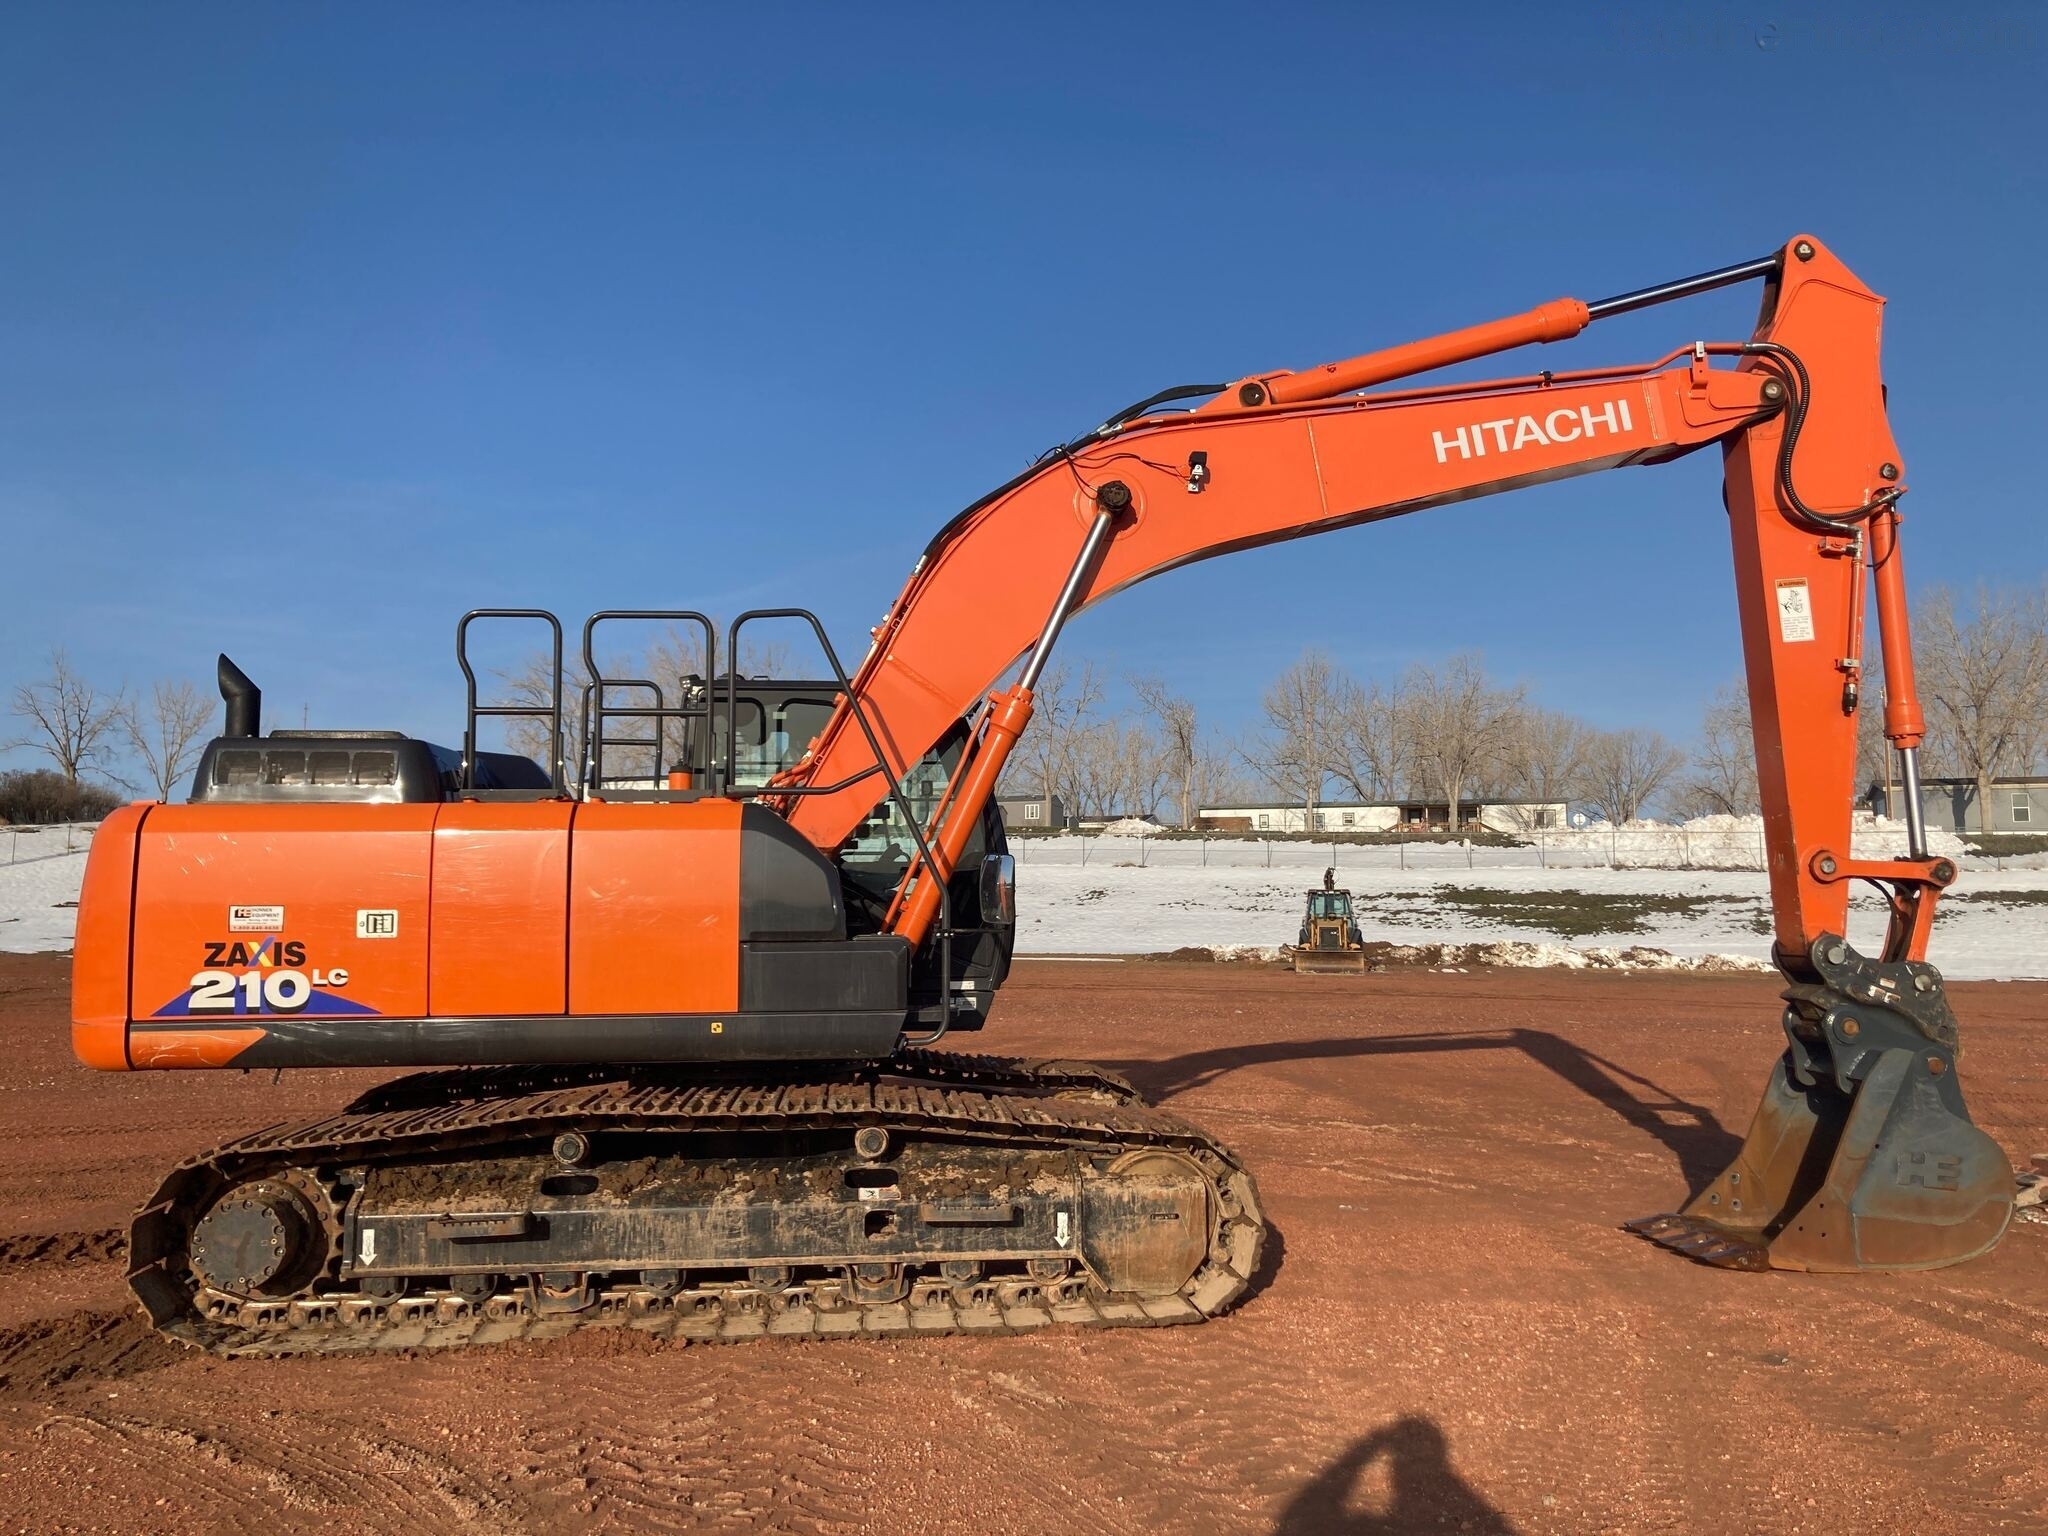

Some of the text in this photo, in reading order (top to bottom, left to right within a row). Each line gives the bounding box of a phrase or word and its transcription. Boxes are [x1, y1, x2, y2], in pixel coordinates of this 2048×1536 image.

[1432, 399, 1633, 464] HITACHI
[204, 936, 306, 967] ZAXIS
[188, 970, 311, 1014] 210
